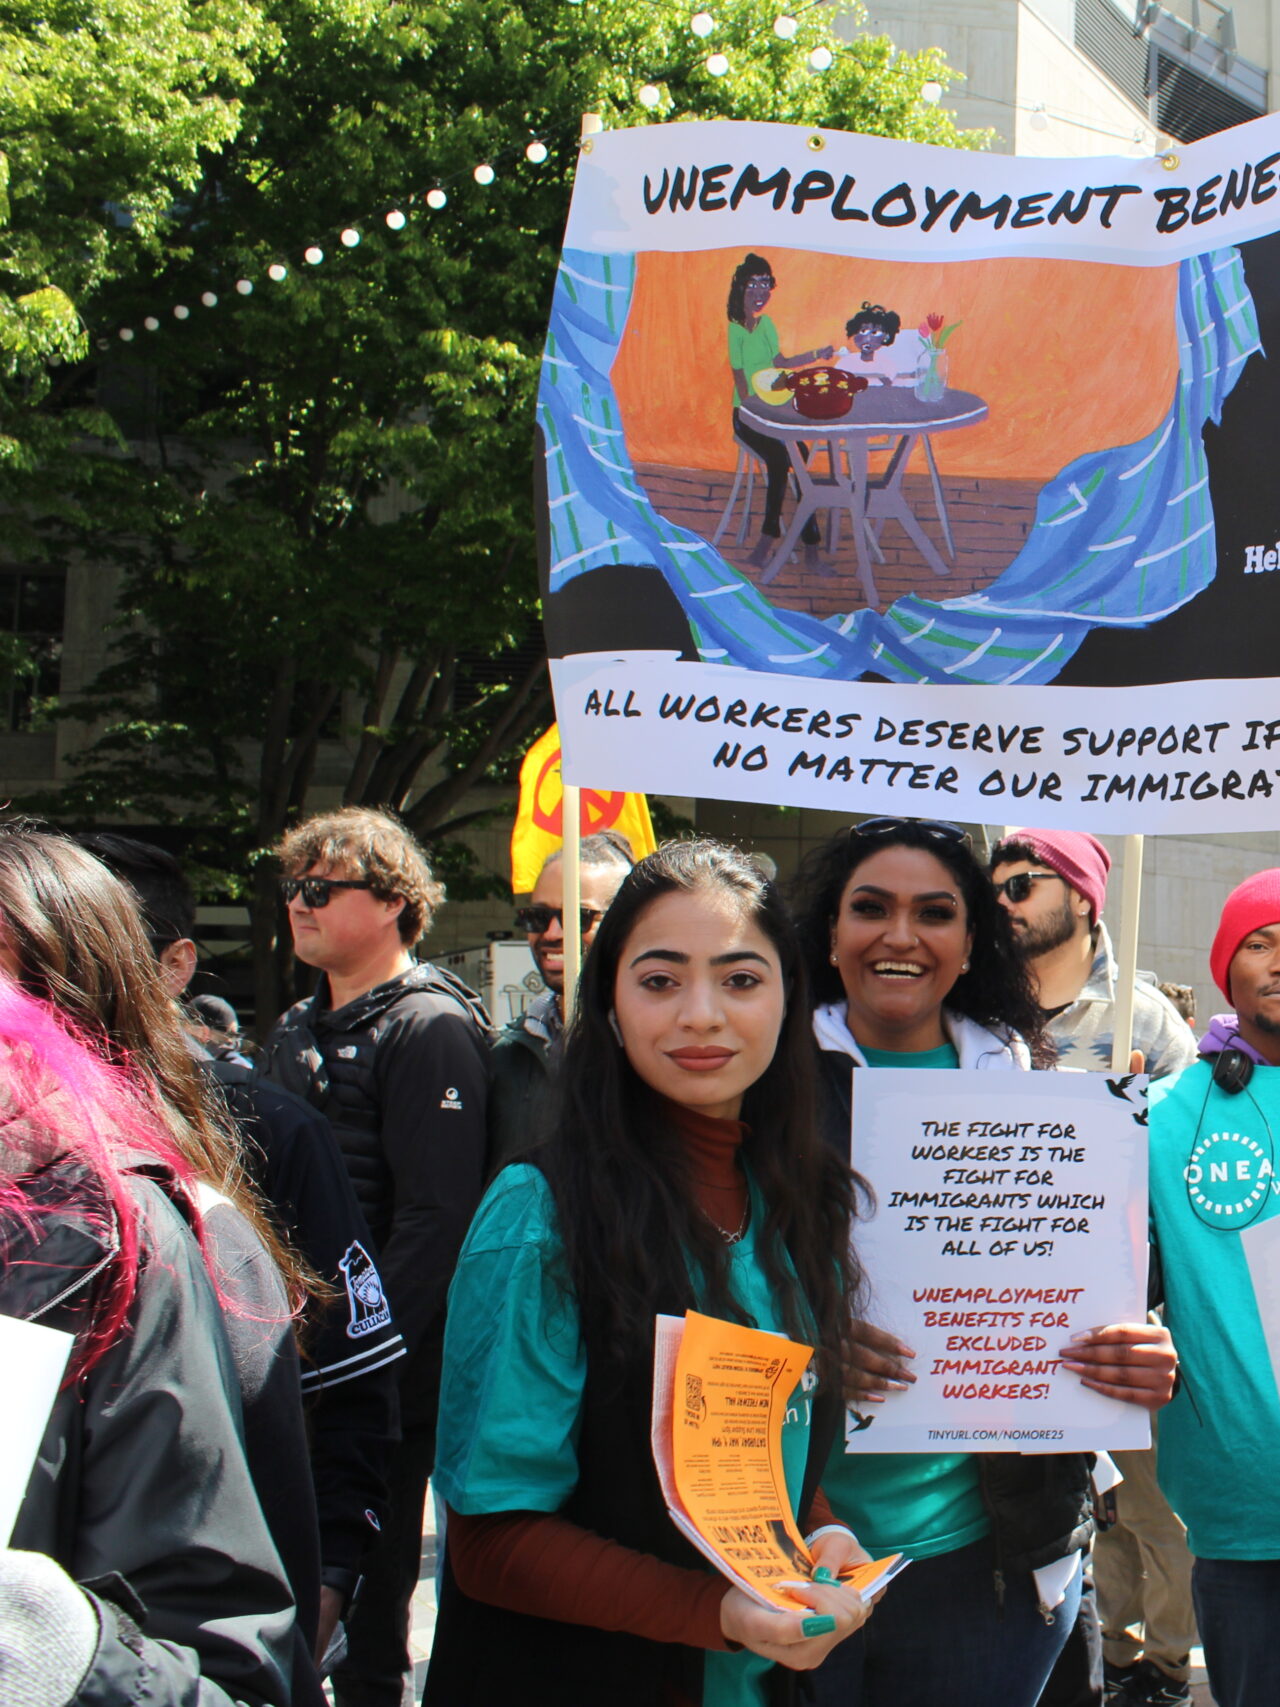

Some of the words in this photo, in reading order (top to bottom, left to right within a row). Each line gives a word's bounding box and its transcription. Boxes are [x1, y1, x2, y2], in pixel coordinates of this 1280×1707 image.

[644, 164, 1142, 232] UNEMPLOYMENT
[585, 690, 641, 717] ALL
[659, 693, 861, 738] WORKERS
[874, 717, 1044, 754] DESERVE
[1063, 722, 1230, 757] SUPPORT
[713, 742, 767, 771] NO
[789, 751, 958, 793] MATTER
[979, 769, 1062, 801] OUR
[922, 1121, 960, 1137] THE
[967, 1122, 1034, 1137] FIGHT
[1038, 1123, 1076, 1139] FOR
[912, 1145, 1014, 1161] WORKERS
[1019, 1146, 1043, 1161] IS
[1048, 1147, 1085, 1162] THE
[943, 1169, 1011, 1184] FIGHT
[1014, 1170, 1053, 1186] FOR
[888, 1192, 1031, 1208] IMMIGRANTS
[1037, 1194, 1104, 1209] WHICH
[904, 1216, 929, 1231] IS
[934, 1216, 973, 1232] THE
[980, 1217, 1047, 1232] FIGHT
[1051, 1217, 1089, 1233] FOR
[942, 1241, 981, 1255] ALL
[989, 1241, 1018, 1256] OF
[1024, 1241, 1053, 1256] US!
[913, 1288, 1084, 1304] UNEMPLOYMENT
[924, 1311, 1024, 1327] BENEFITS
[1030, 1312, 1069, 1328] FOR
[946, 1336, 1046, 1351] EXCLUDED
[931, 1359, 1062, 1376] IMMIGRANT
[943, 1384, 1049, 1399] WORKERS!
[928, 1430, 1064, 1440] TINYURL.COM/NOMORE25
